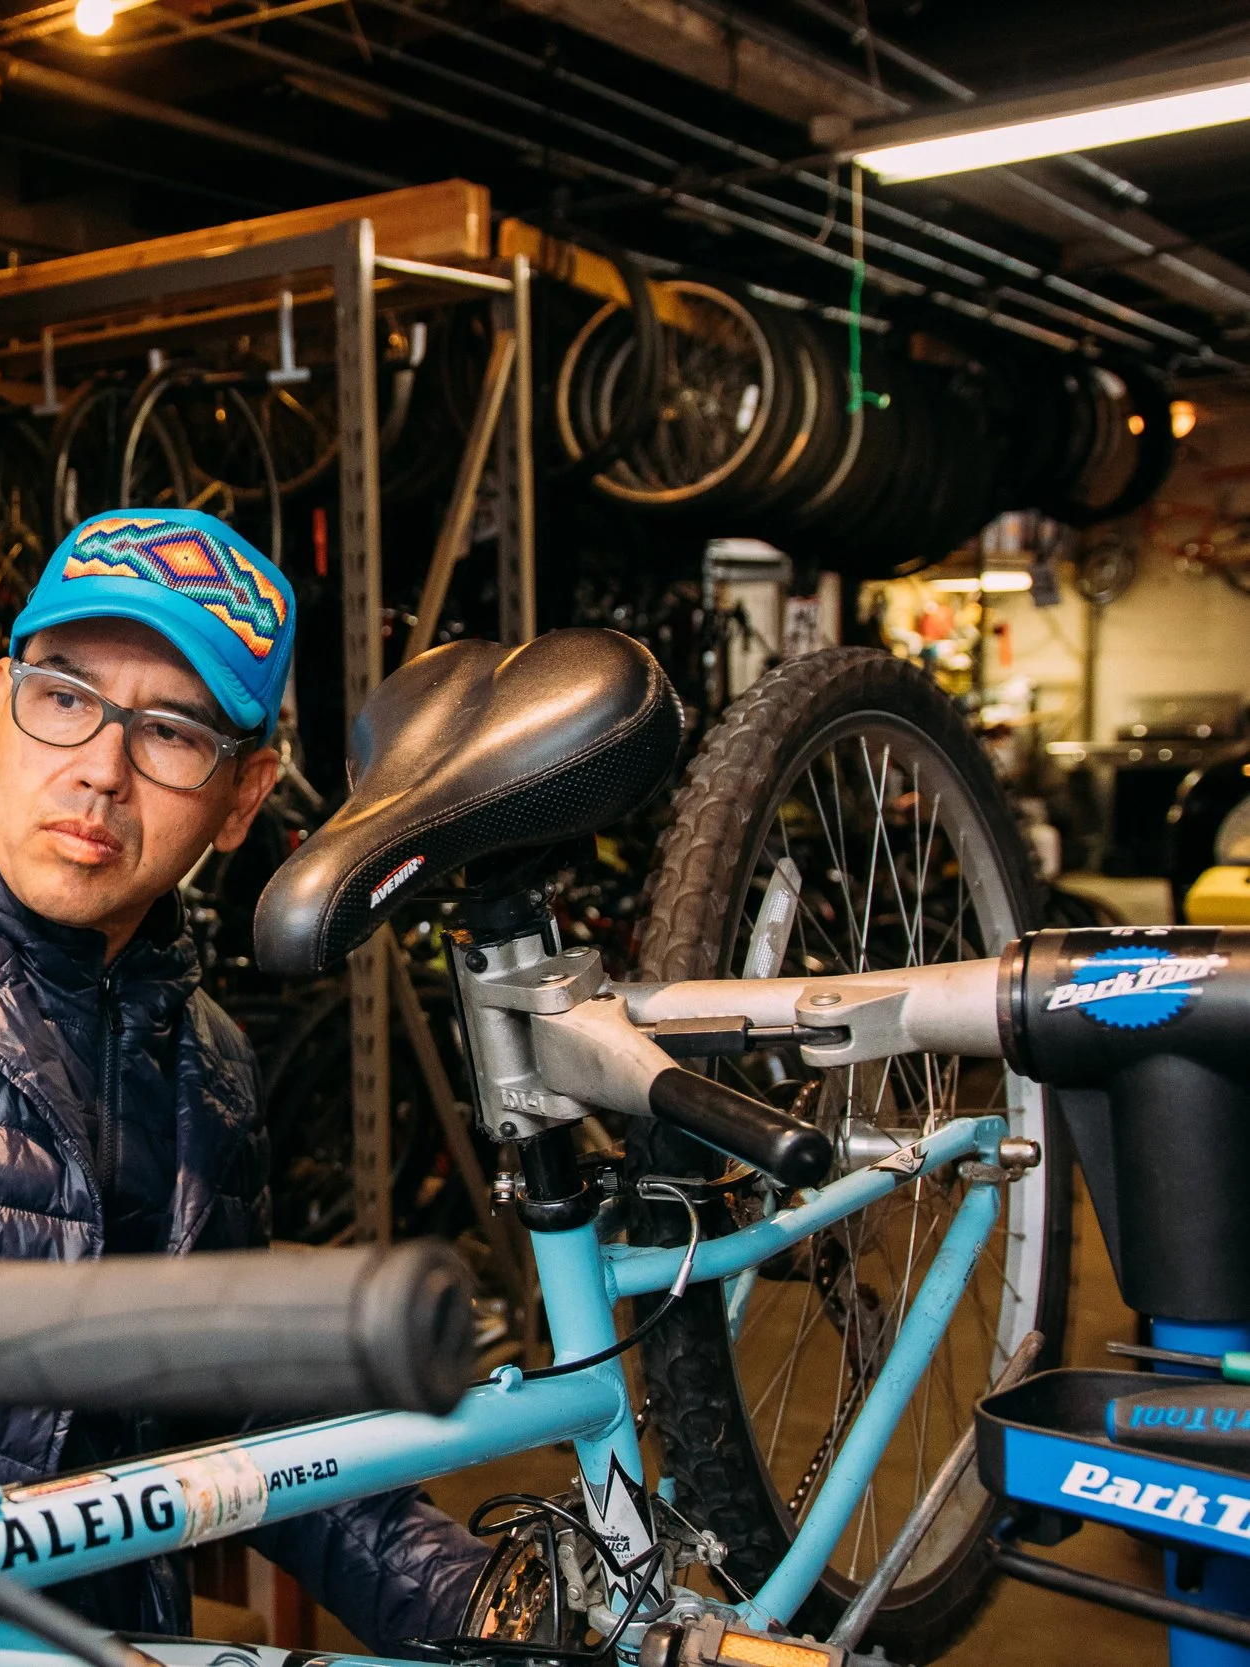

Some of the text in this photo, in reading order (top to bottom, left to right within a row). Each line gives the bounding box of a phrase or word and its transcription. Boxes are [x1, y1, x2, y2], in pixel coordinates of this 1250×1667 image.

[370, 858, 419, 909] AVENIR
[264, 1457, 338, 1493] AVE-2.0
[607, 1541, 631, 1553] USA
